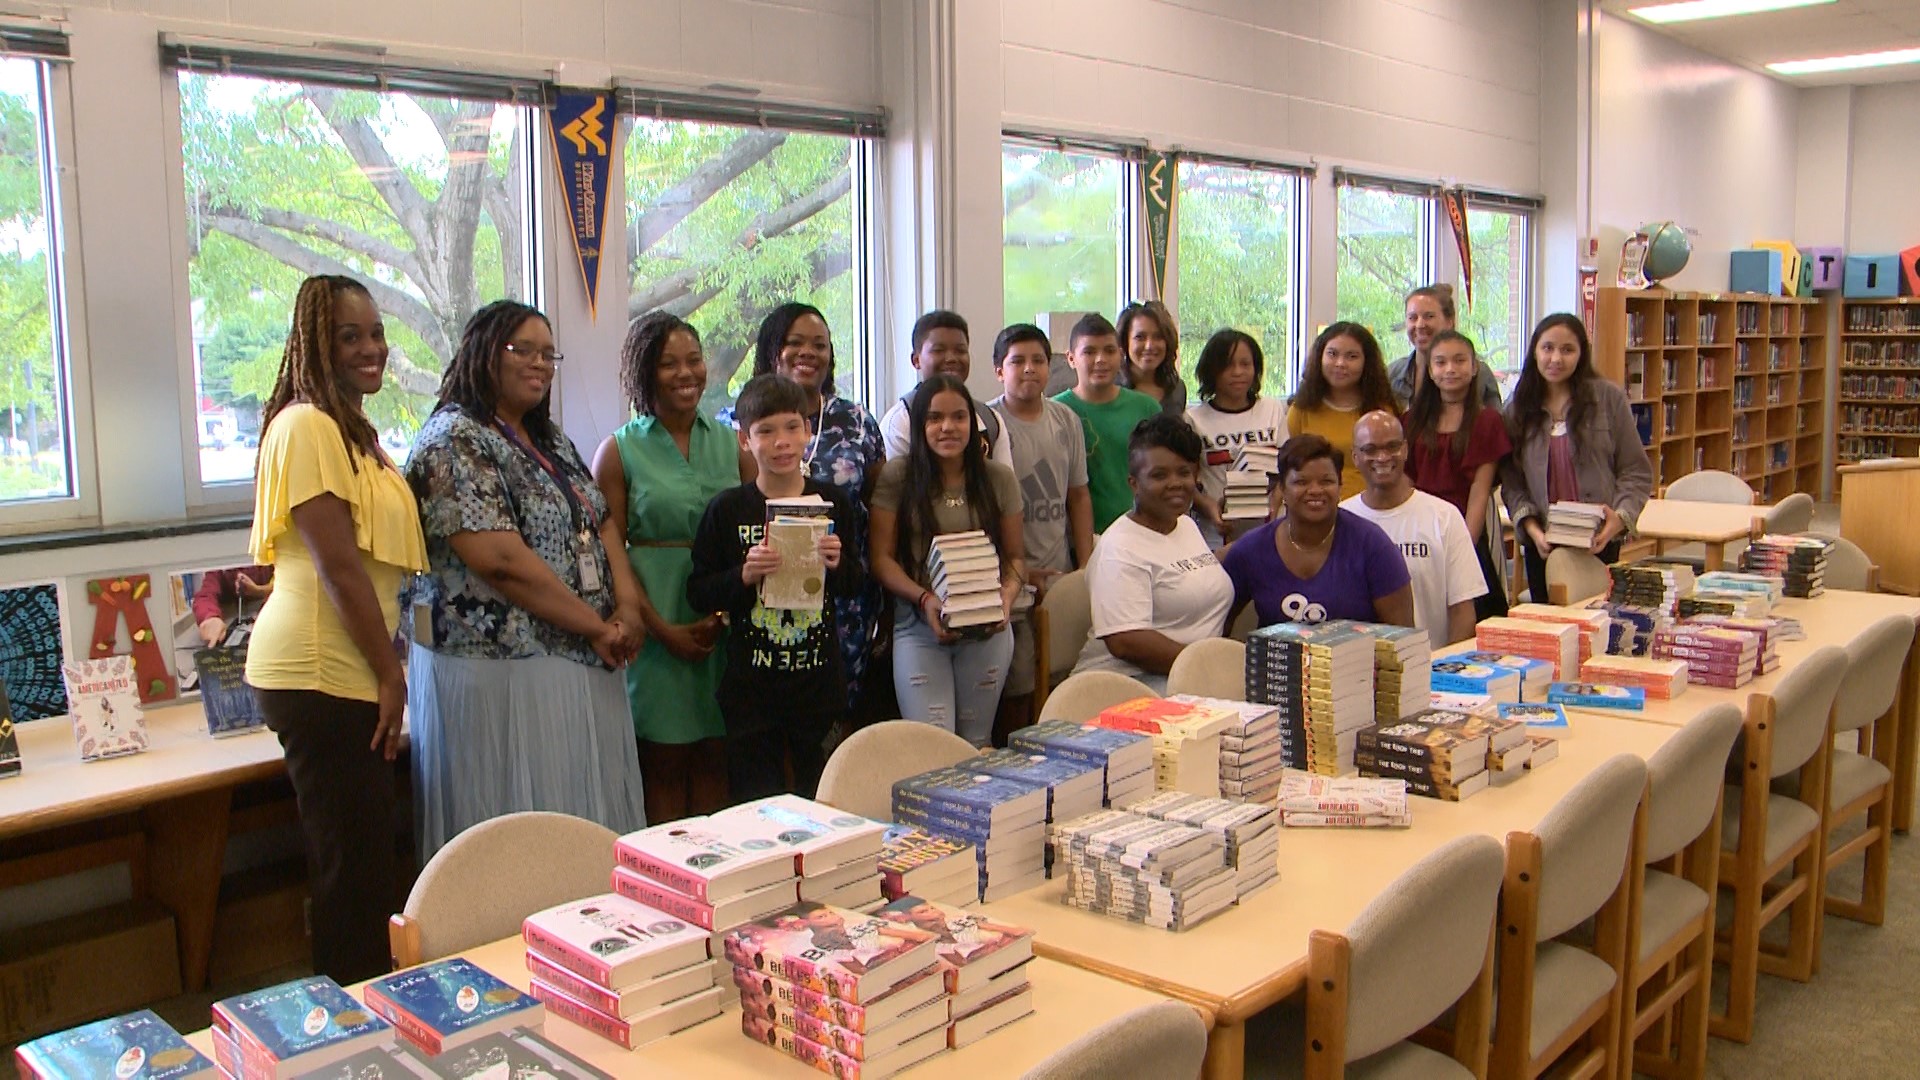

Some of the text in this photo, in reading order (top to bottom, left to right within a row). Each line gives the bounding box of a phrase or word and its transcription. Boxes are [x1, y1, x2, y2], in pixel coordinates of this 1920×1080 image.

[1202, 428, 1276, 448] LOVELY
[1400, 543, 1428, 558] ITED
[752, 649, 772, 667] IN
[624, 853, 638, 868] THE
[640, 860, 661, 878] HATE
[671, 873, 692, 891] GIVE
[622, 881, 638, 897] THE
[674, 901, 697, 920] GIVE
[770, 960, 811, 984] BELLES
[778, 987, 818, 1012] BELLES
[557, 1000, 579, 1018] HATE
[591, 1017, 613, 1035] GIVE
[781, 1013, 820, 1038] BELLES
